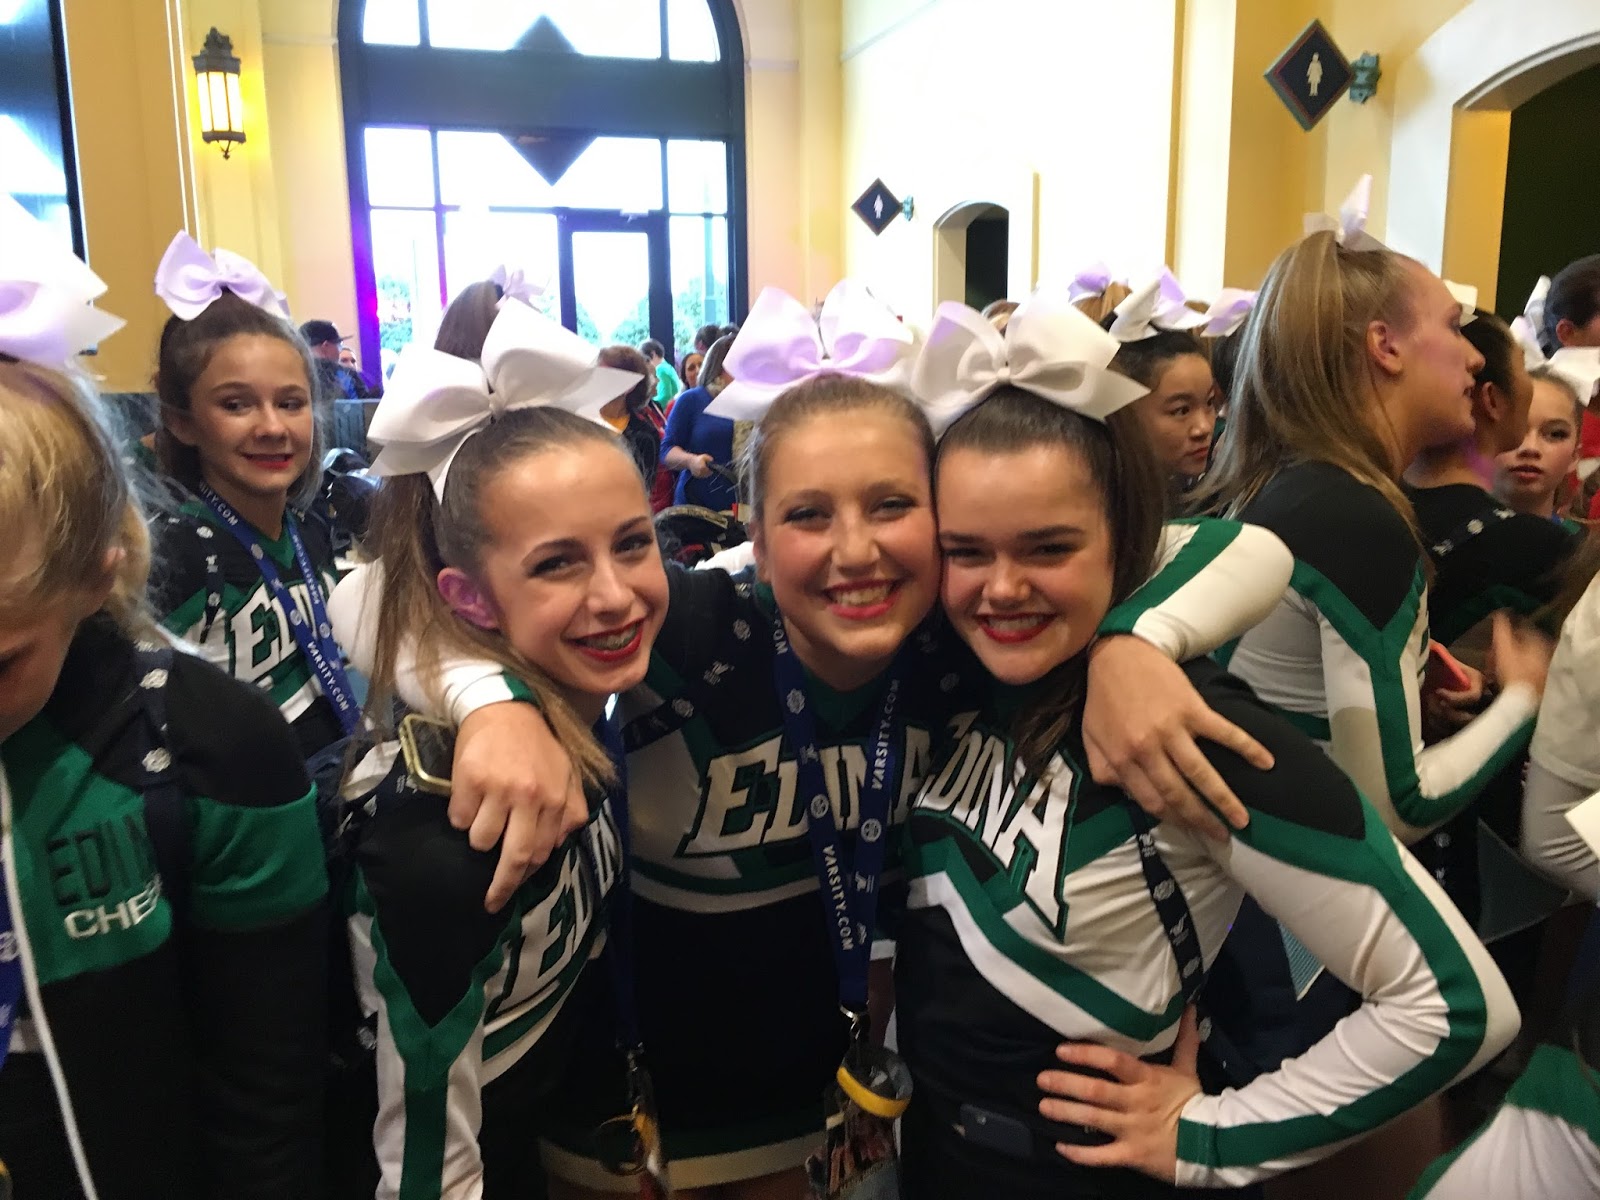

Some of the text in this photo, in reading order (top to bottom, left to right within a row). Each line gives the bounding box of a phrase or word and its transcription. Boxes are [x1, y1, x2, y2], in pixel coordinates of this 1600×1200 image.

[306, 640, 350, 712] VARSITY.COM
[870, 678, 899, 791] VARSITY.COM
[822, 844, 855, 951] VARSITY.COM
